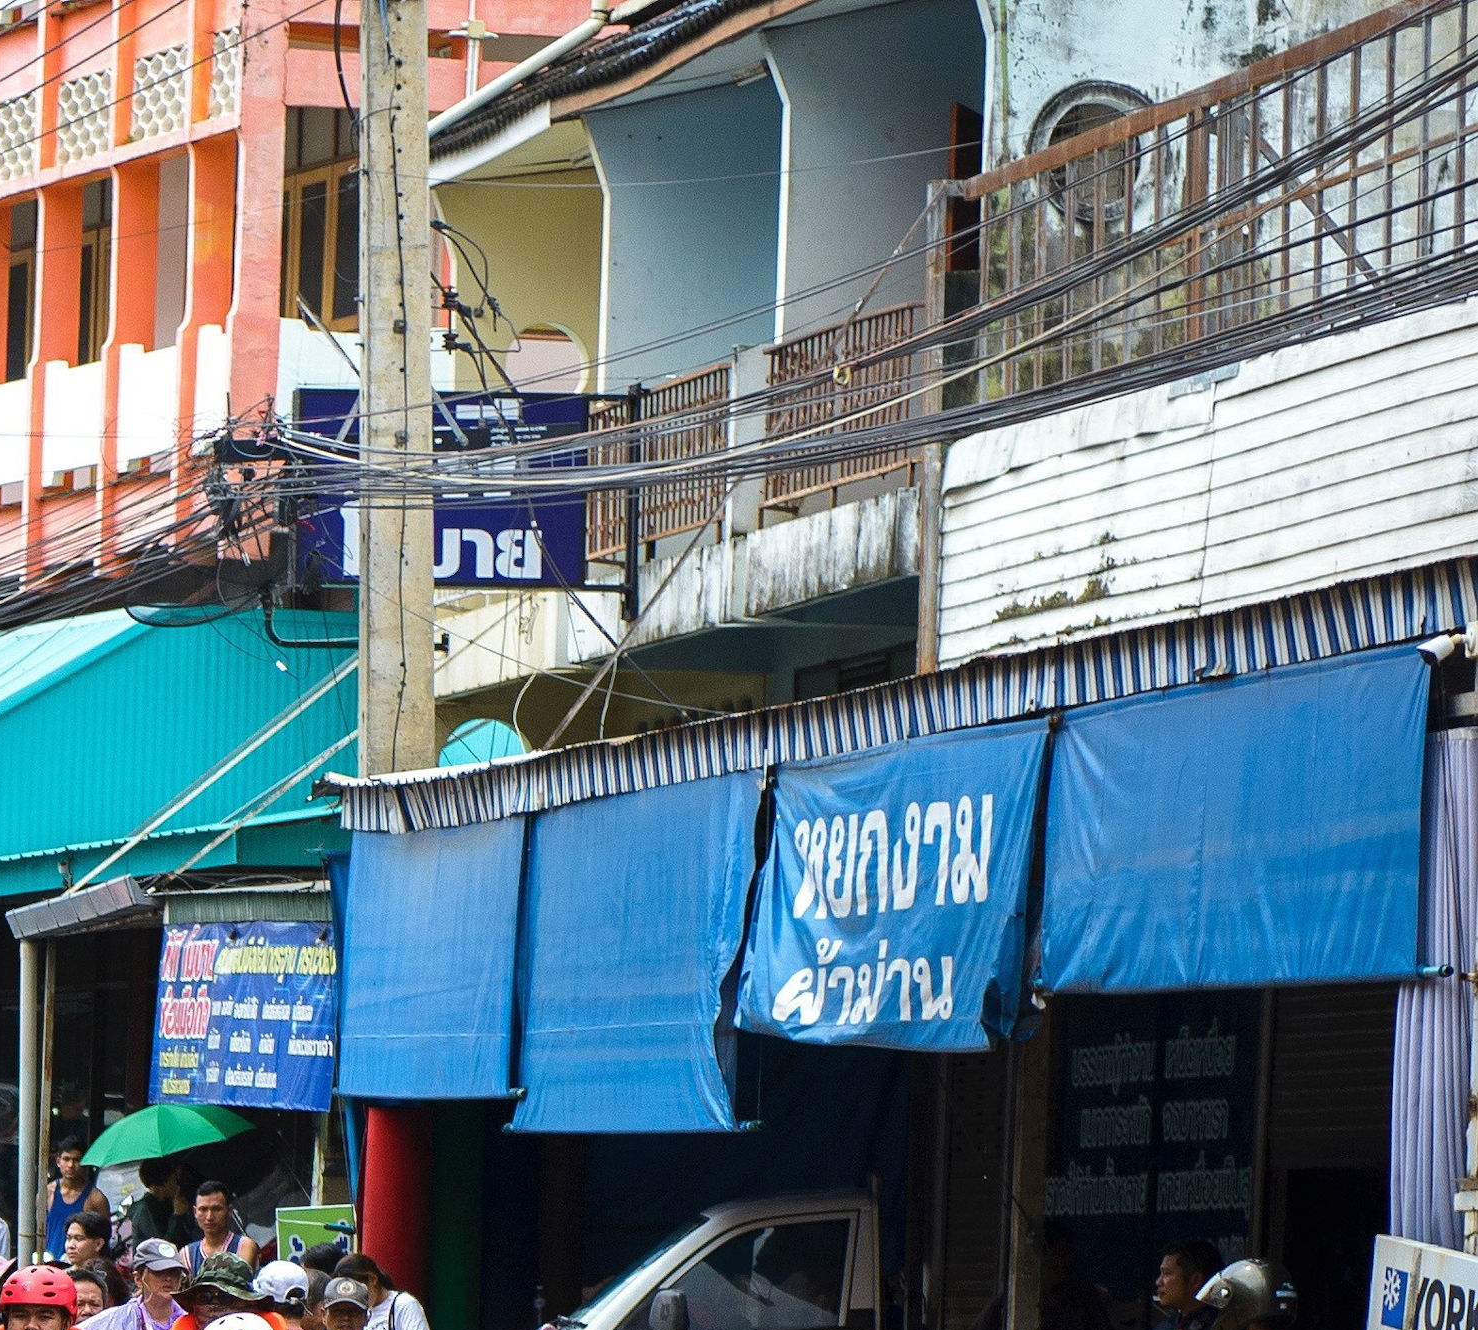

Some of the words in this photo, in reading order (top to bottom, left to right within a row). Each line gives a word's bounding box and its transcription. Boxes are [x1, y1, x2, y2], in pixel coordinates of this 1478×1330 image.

[793, 793, 993, 919] หยกงาม
[772, 937, 954, 1025] ผ้าม่าน
